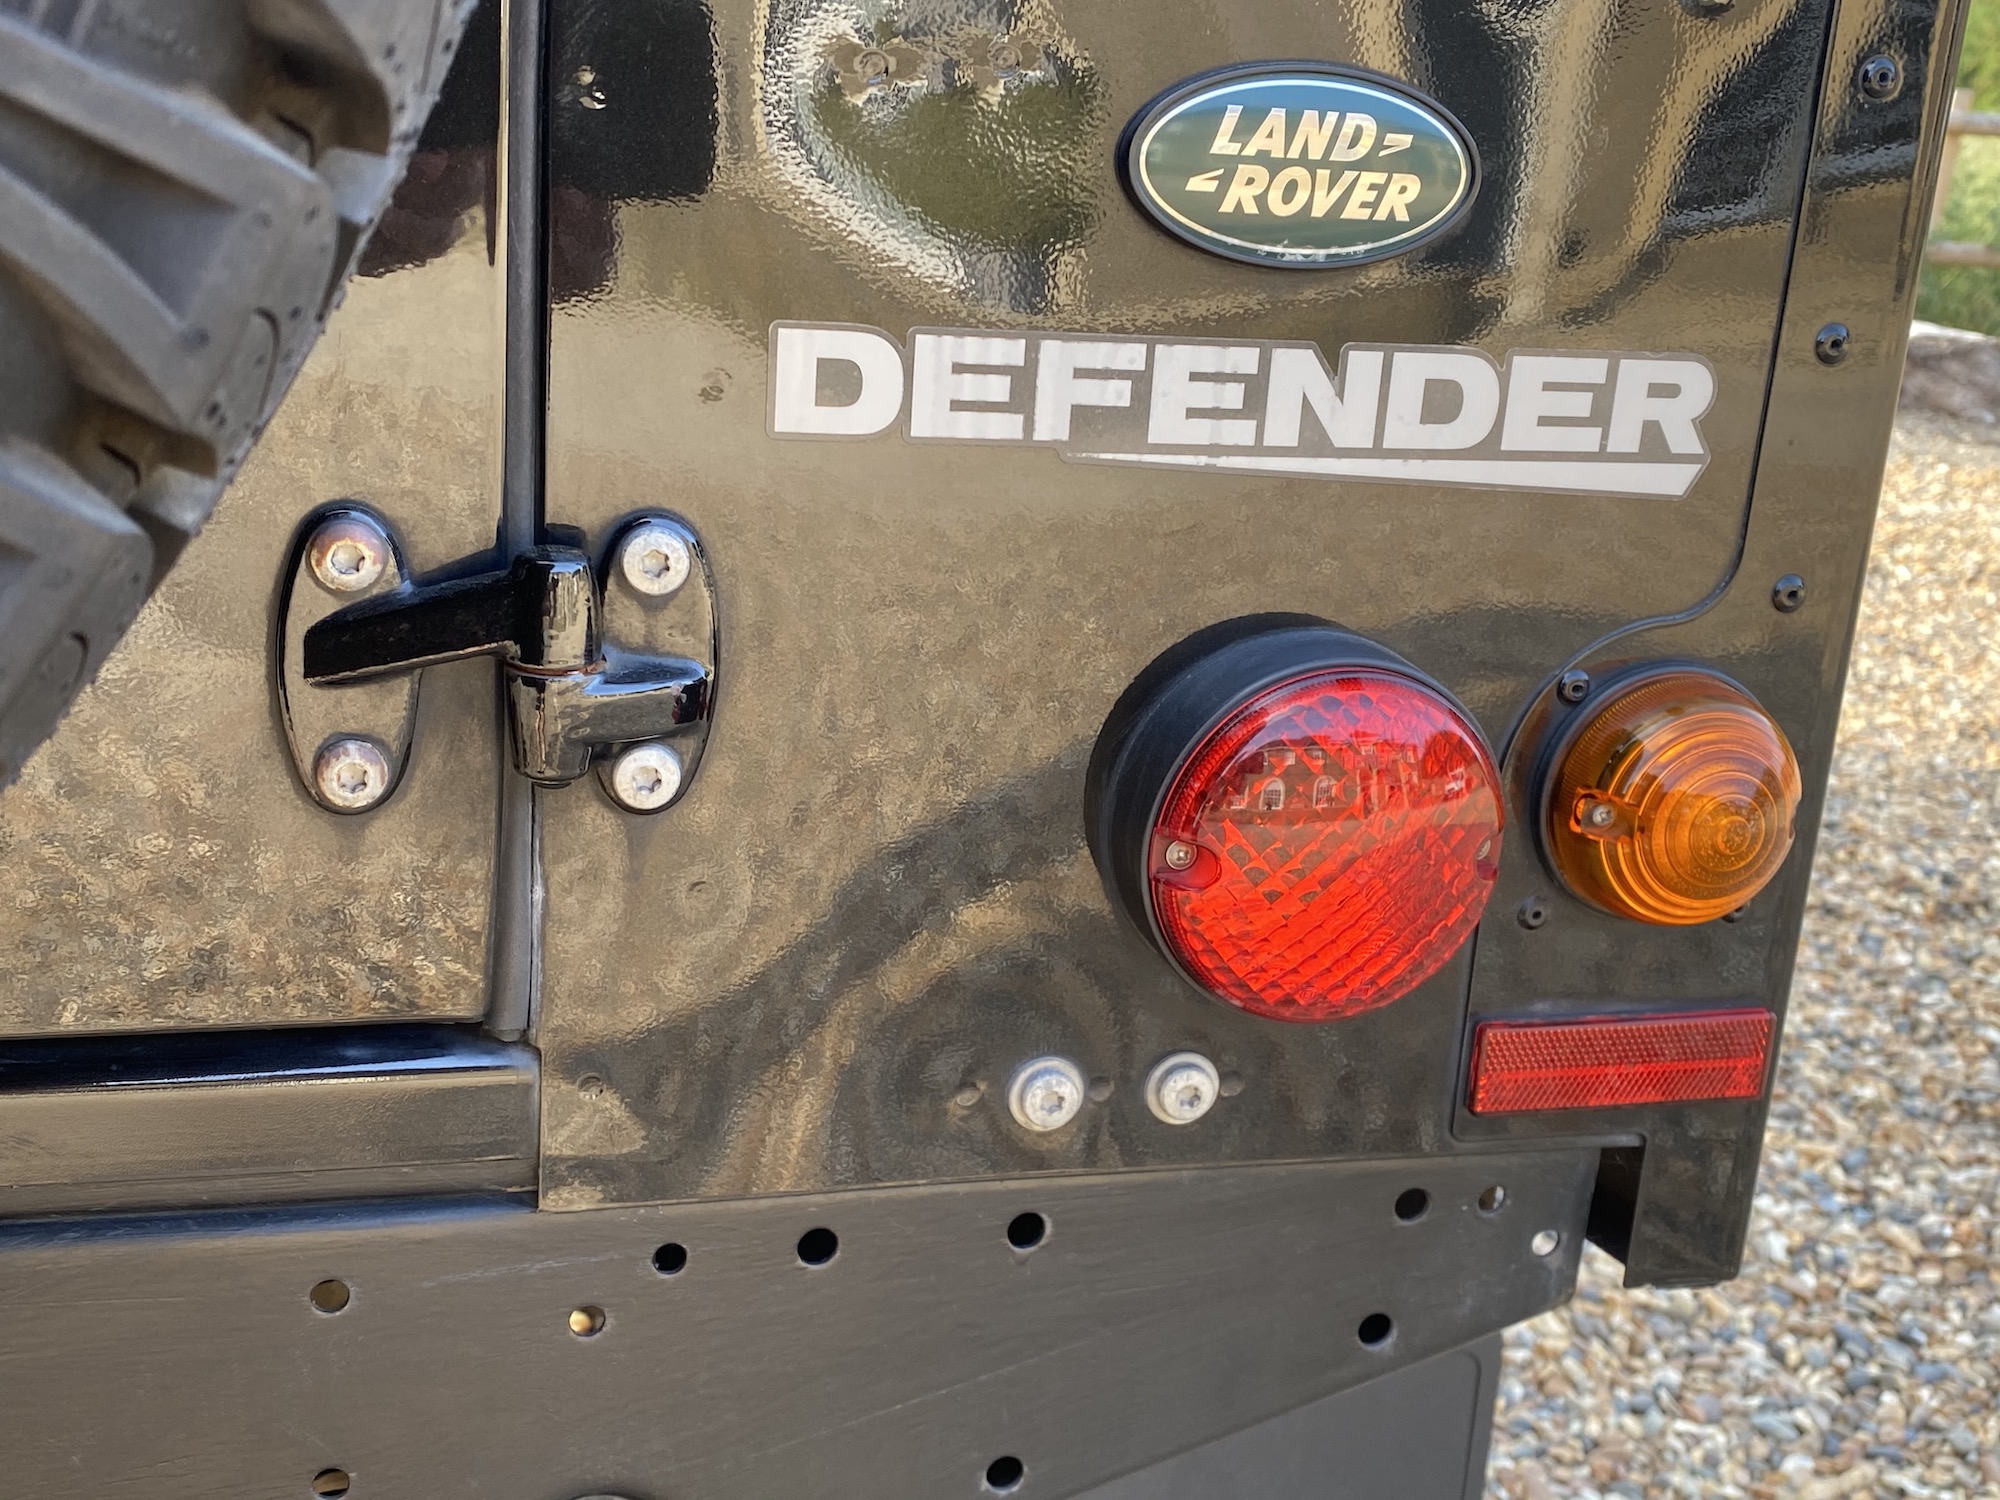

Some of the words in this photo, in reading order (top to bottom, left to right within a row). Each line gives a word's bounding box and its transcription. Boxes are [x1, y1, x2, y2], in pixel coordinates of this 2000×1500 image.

[1209, 104, 1378, 161] LAND
[1218, 164, 1422, 222] ROVER
[774, 328, 1714, 455] DEFENDER
